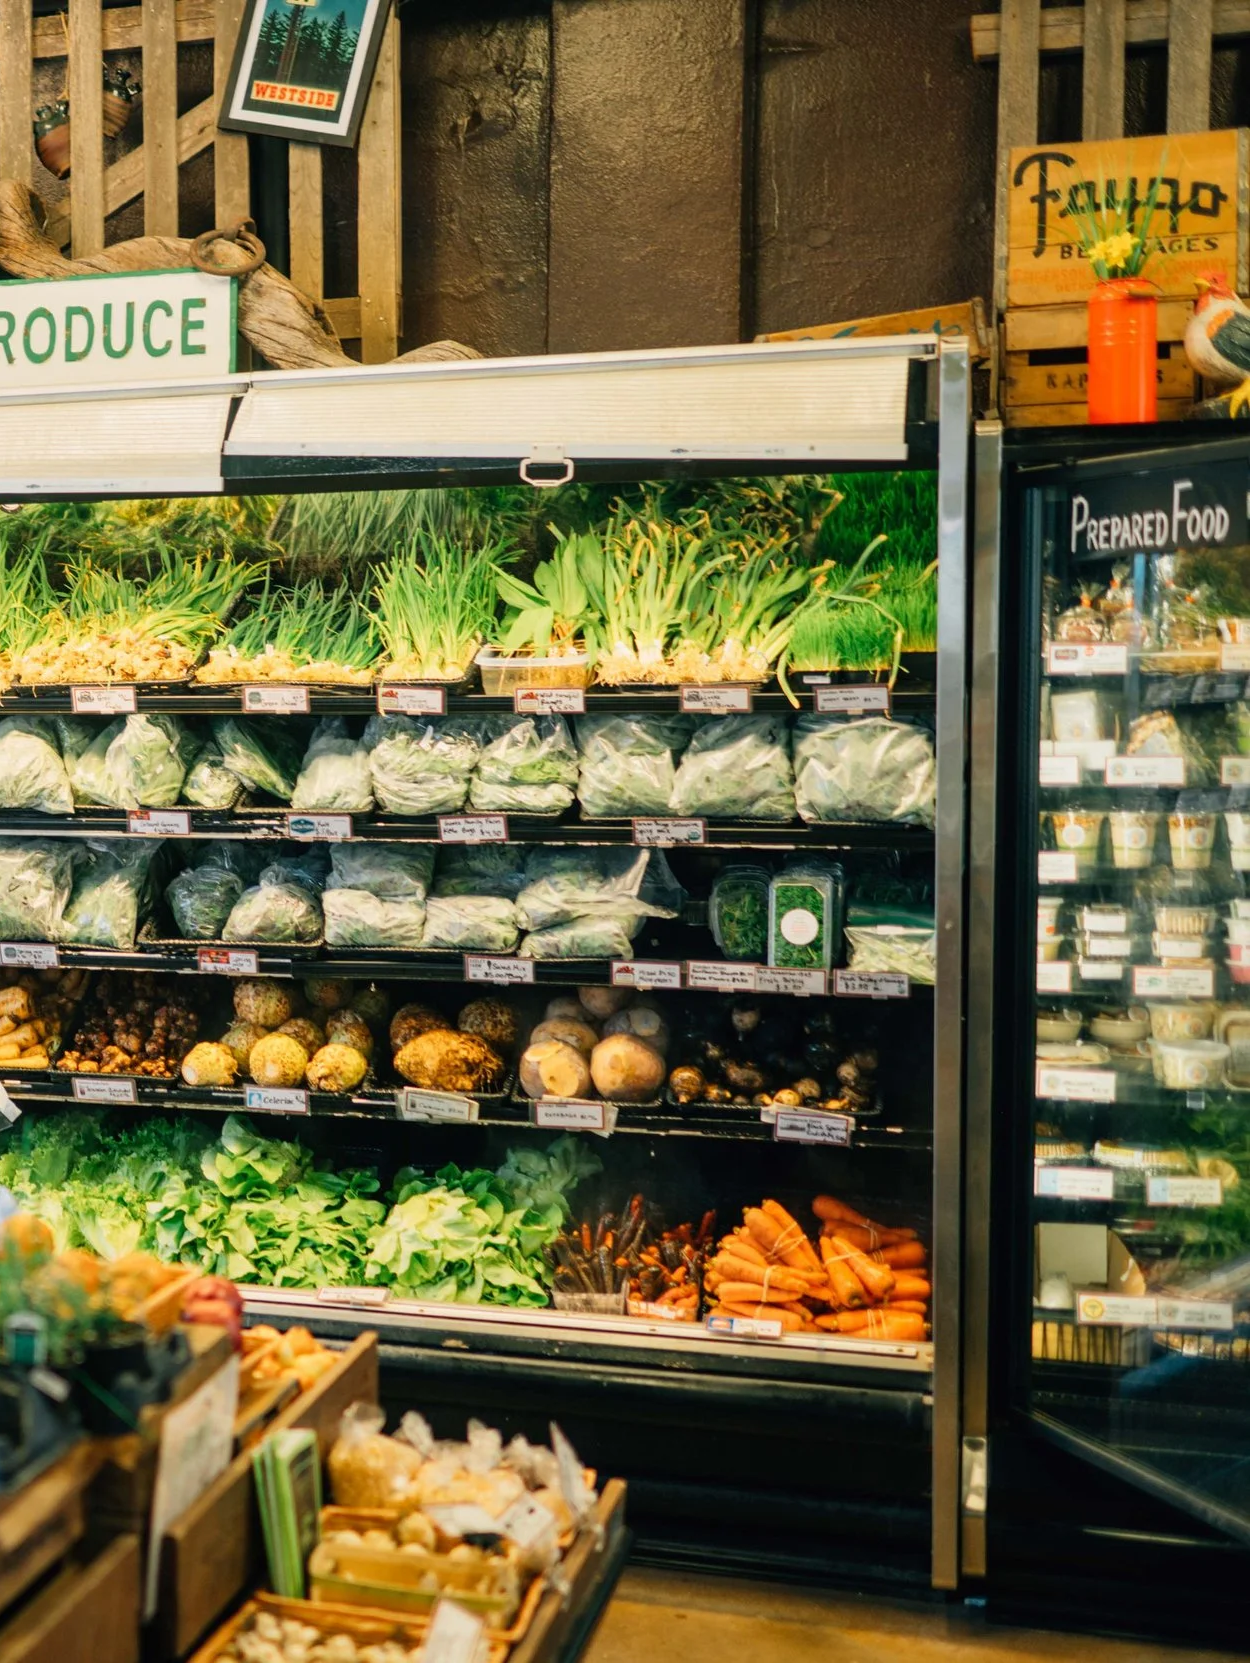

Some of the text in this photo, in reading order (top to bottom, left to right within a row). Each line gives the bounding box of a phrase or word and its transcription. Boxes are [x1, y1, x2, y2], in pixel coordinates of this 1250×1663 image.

[253, 82, 336, 108] WESTSIDE
[1060, 236, 1219, 260] BEAGES
[1070, 477, 1230, 554] PREPARED FOOD
[263, 1095, 294, 1106] Celeriac
